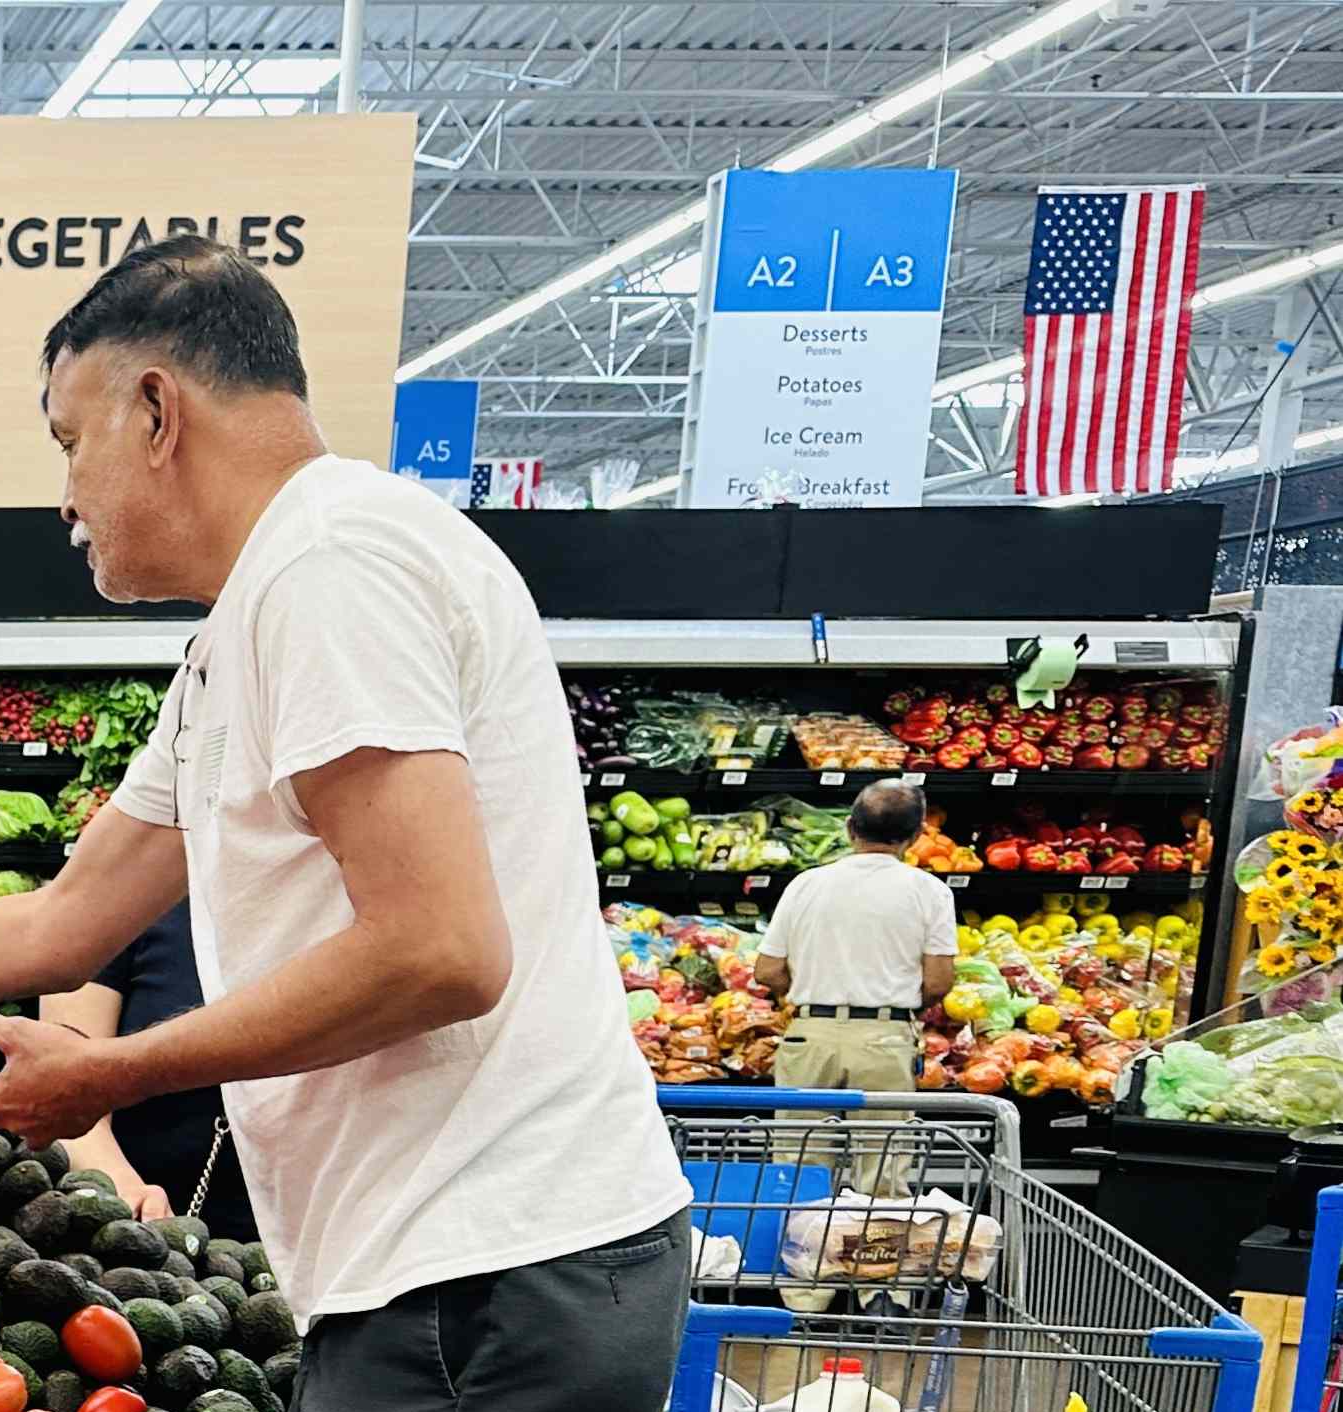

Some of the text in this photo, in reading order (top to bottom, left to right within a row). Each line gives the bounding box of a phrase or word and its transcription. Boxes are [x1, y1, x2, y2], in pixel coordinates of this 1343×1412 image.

[747, 255, 797, 287] A2
[865, 255, 914, 287] A3
[783, 324, 868, 342] Desserts
[778, 375, 863, 393] Potatoes
[764, 427, 863, 445] Ice Cream
[417, 440, 452, 462] A5
[799, 477, 891, 496] Breakfast
